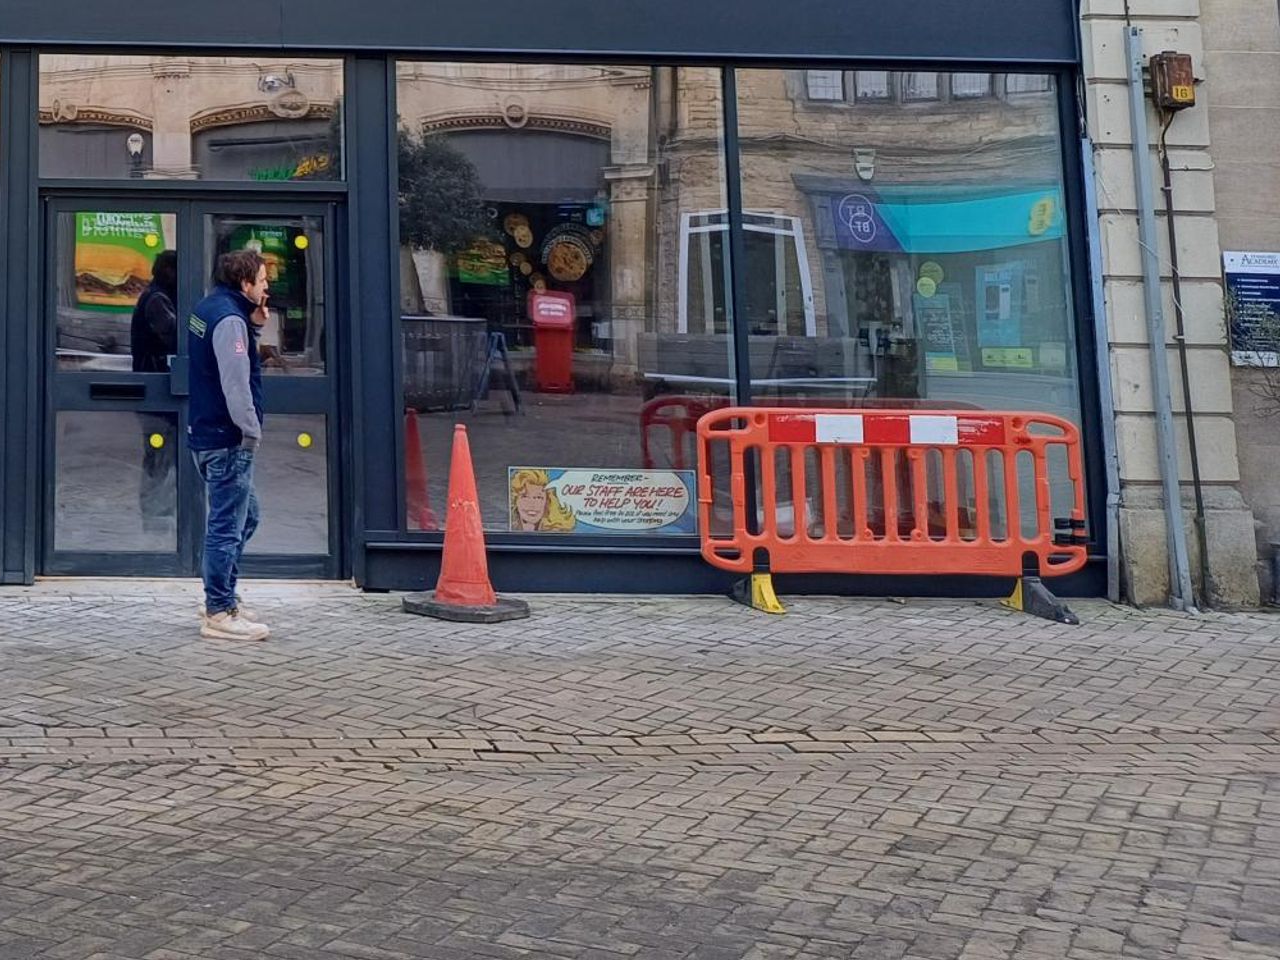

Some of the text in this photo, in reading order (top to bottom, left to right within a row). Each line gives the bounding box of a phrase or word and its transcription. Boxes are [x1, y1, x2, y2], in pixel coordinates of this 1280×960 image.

[1175, 87, 1188, 99] 16
[561, 484, 684, 498] OUR STAFF ARE HERE
[583, 498, 663, 511] TO HELP YOU!
